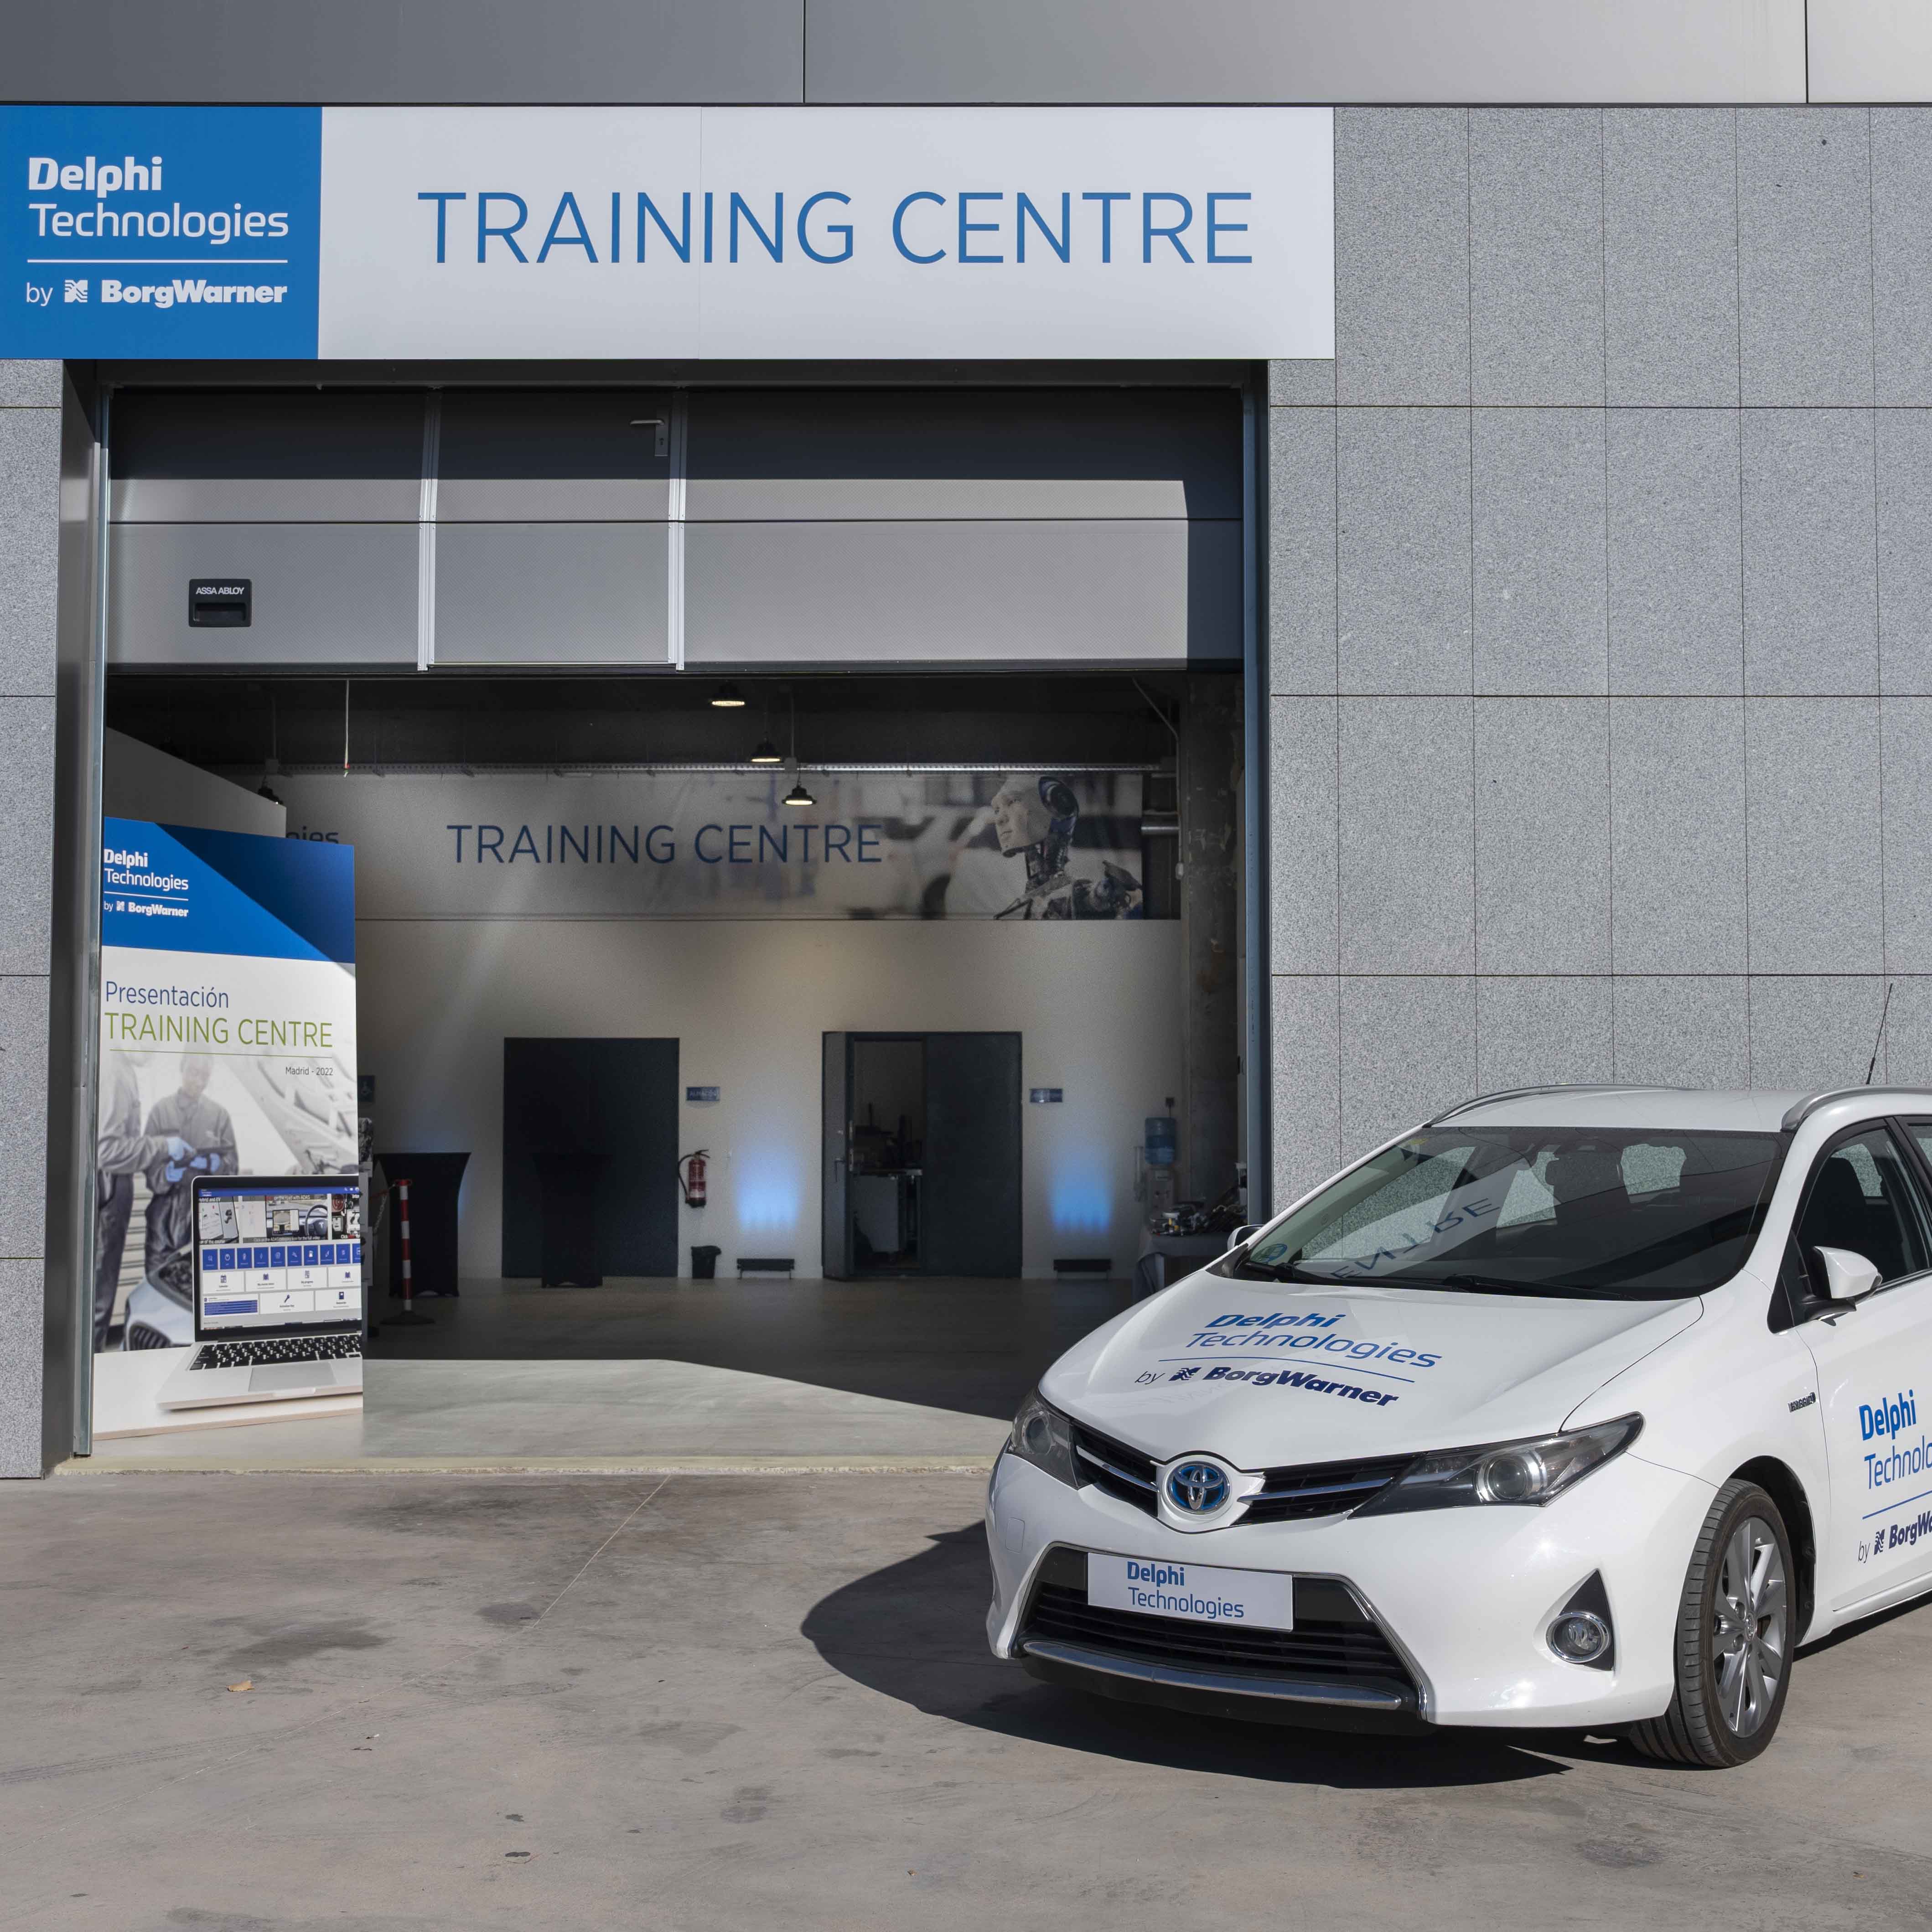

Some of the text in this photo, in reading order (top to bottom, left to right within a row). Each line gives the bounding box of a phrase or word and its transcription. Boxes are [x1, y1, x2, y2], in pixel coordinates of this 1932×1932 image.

[29, 156, 162, 198] Delphi
[29, 202, 289, 244] Technologies
[418, 191, 1253, 264] TRAINING CENTRE
[26, 280, 287, 308] by BorgWarner
[104, 849, 148, 869] Delphi
[447, 824, 881, 865] TRAINING CENTRE
[104, 868, 189, 891] Technologies
[104, 901, 189, 917] by BorgWarner
[106, 981, 229, 1008] Presentación
[104, 1012, 333, 1048] TRAINING CENTRE
[285, 1067, 309, 1076] Madrid
[316, 1067, 333, 1076] 2022
[1205, 1313, 1347, 1329] Delphi
[1186, 1330, 1443, 1367] Technologies
[1134, 1371, 1165, 1385] by
[1202, 1367, 1399, 1407] BorgWarner
[1859, 1389, 1916, 1441] Delphi
[1858, 1541, 1870, 1564] by
[1127, 1561, 1185, 1587] Delphi
[1127, 1587, 1244, 1619] Technologies
